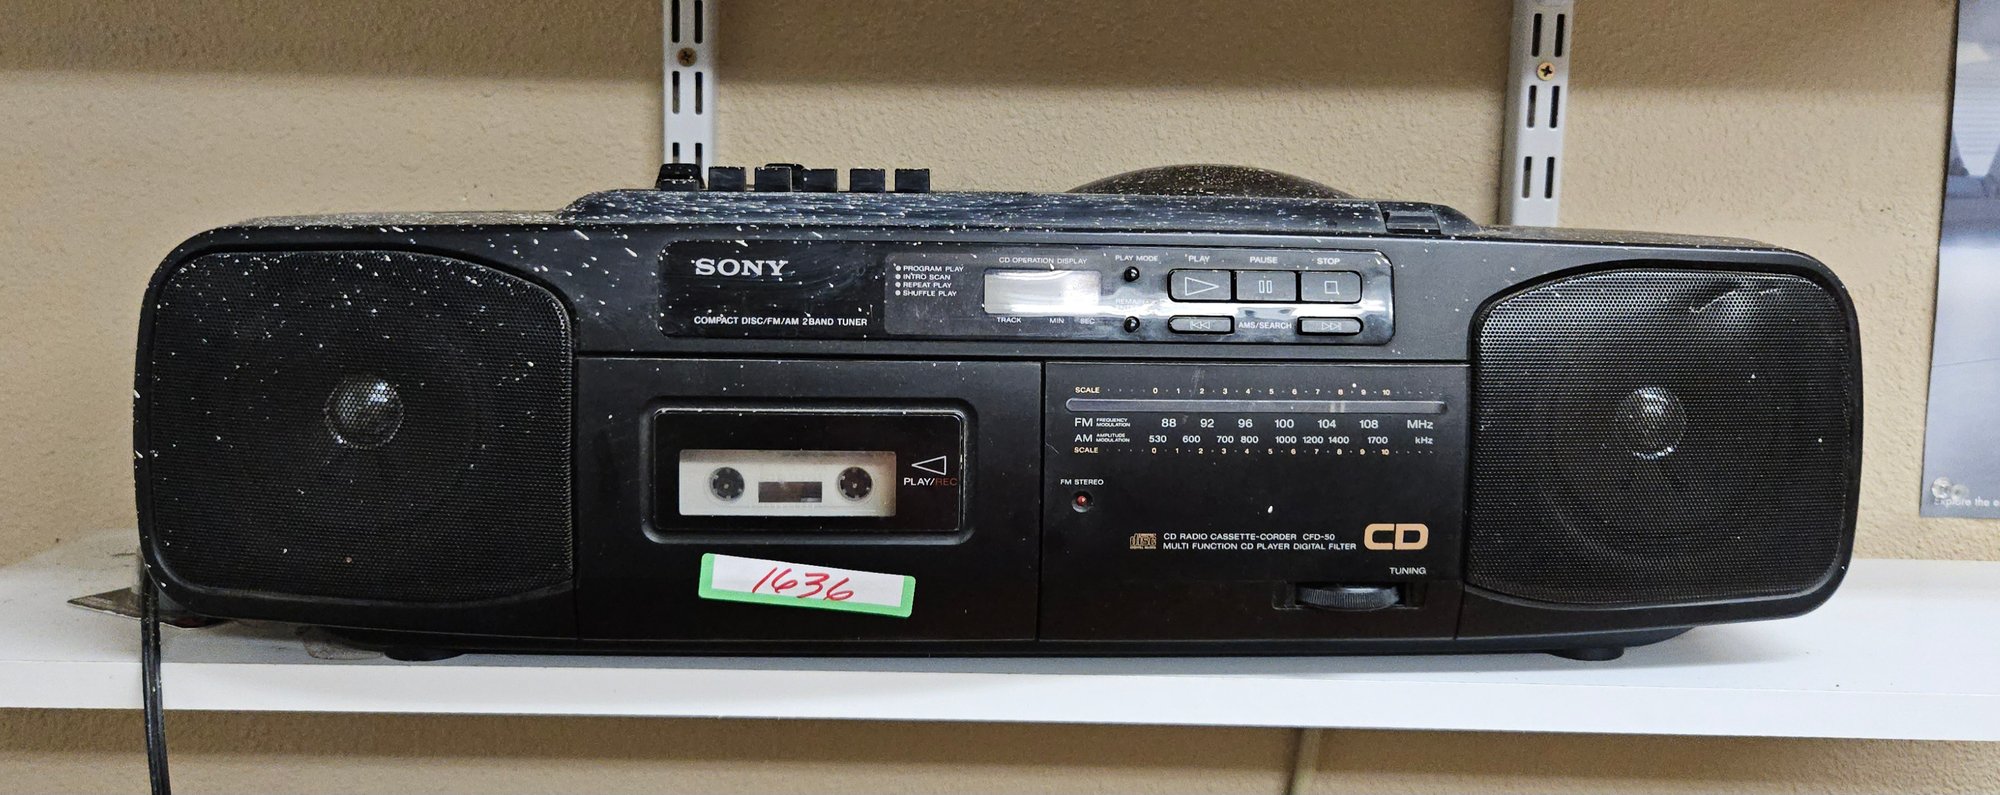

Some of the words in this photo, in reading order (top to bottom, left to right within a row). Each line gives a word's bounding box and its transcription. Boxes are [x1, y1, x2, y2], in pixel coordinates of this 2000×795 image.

[695, 258, 788, 276] SONY
[694, 316, 739, 325] COMPACT
[742, 317, 799, 325] DISC/FM/AM
[802, 317, 834, 326] 2BAND
[838, 318, 867, 326] TUNER
[1074, 417, 1093, 427] FM
[1161, 418, 1176, 428] 88
[1200, 419, 1214, 428] 92
[1238, 419, 1253, 428] 96
[1275, 419, 1294, 428] 100
[1318, 419, 1336, 428] 104
[1359, 419, 1378, 429] 108
[1407, 419, 1433, 429] MHz
[1074, 434, 1092, 442] AM
[1275, 436, 1297, 444] 1000
[1302, 436, 1324, 444] 1200
[1328, 436, 1349, 444] 1400
[1415, 436, 1433, 445] kHz
[903, 477, 958, 486] PLAY/REC
[1974, 496, 1990, 506] the
[1364, 523, 1429, 550] CD
[1389, 567, 1426, 575] TUNING
[752, 566, 854, 601] 1636
